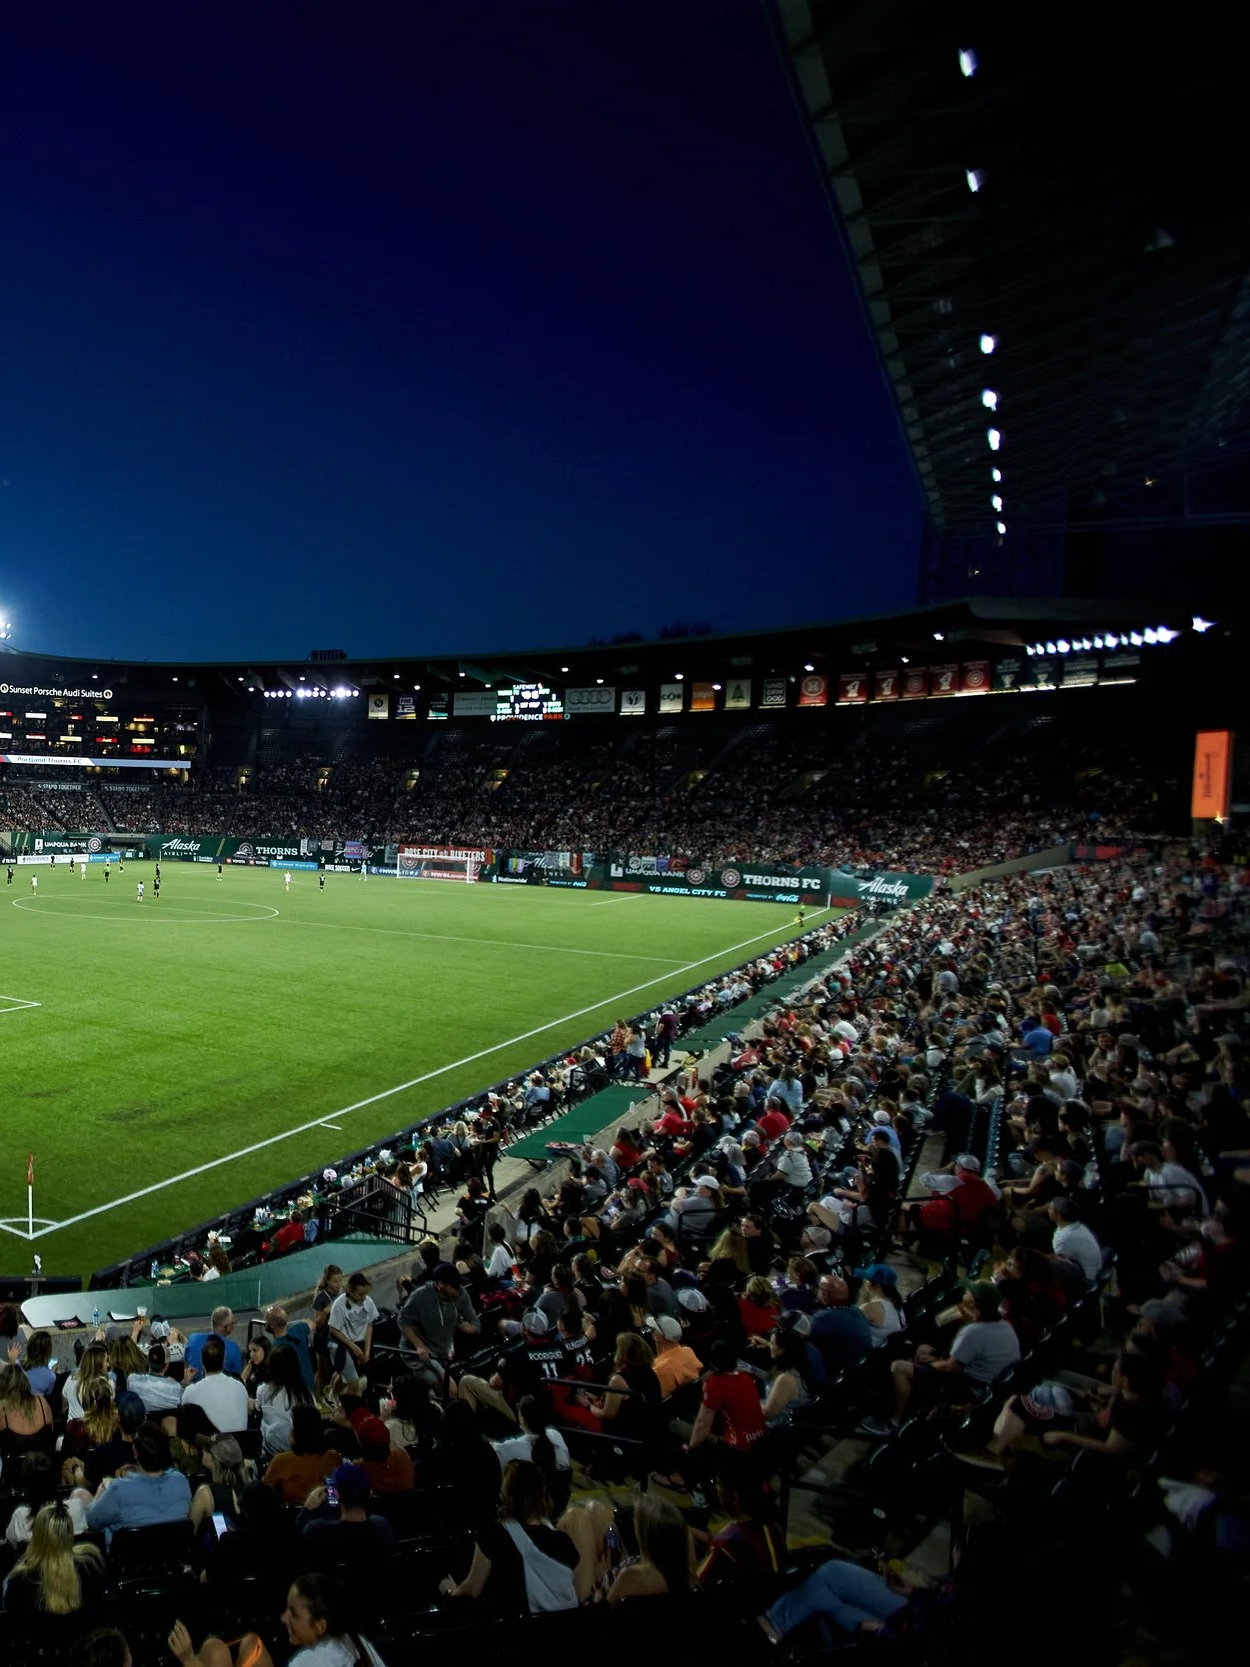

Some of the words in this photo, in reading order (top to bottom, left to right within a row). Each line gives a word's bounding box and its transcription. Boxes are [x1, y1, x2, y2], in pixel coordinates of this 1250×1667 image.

[9, 685, 33, 695] Sunset
[34, 687, 62, 696] Porsche
[63, 689, 80, 697] Audi
[81, 689, 102, 698] Suites
[397, 705, 416, 713] 12
[162, 838, 201, 852] Alaska
[256, 846, 298, 856] THORNS
[498, 876, 528, 884] Nationwide
[743, 874, 800, 888] THORNS
[801, 878, 821, 890] FC
[858, 876, 910, 897] Alaska
[662, 887, 691, 895] ANGEL
[541, 1361, 559, 1379] 11
